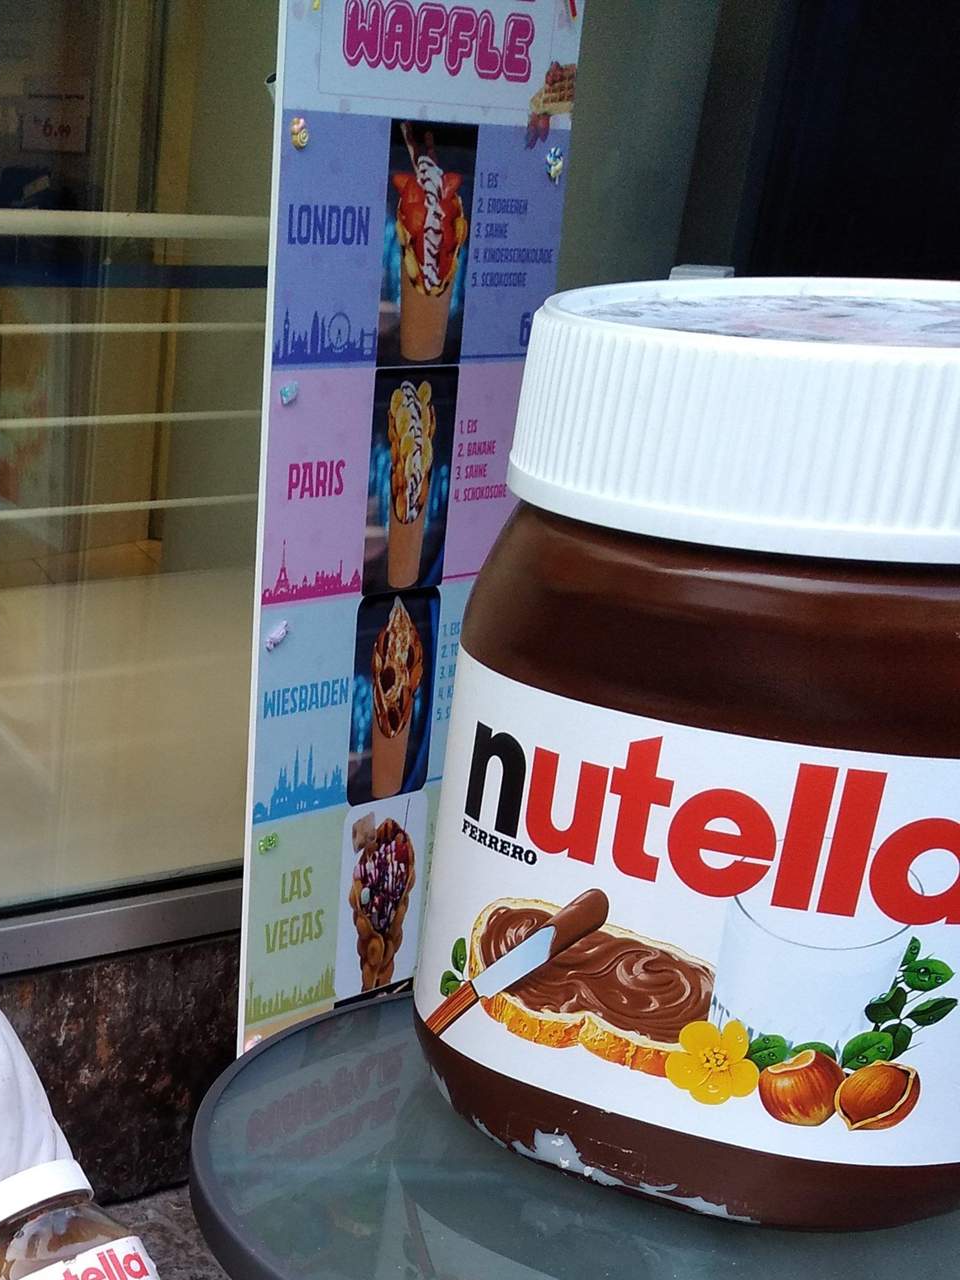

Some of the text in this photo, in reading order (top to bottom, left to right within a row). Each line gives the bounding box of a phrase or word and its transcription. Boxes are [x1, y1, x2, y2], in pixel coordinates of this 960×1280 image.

[343, 0, 534, 83] WAFFLE
[287, 204, 370, 246] LONDON
[467, 419, 477, 434] EIS
[467, 441, 496, 456] BANANE
[287, 459, 346, 500] PARIS
[464, 464, 488, 479] SAHNE
[263, 677, 349, 720] WIESBADEN
[461, 818, 538, 866] FERRERO
[464, 720, 960, 926] nutella
[280, 866, 313, 904] LAS
[265, 908, 324, 954] VEGAS
